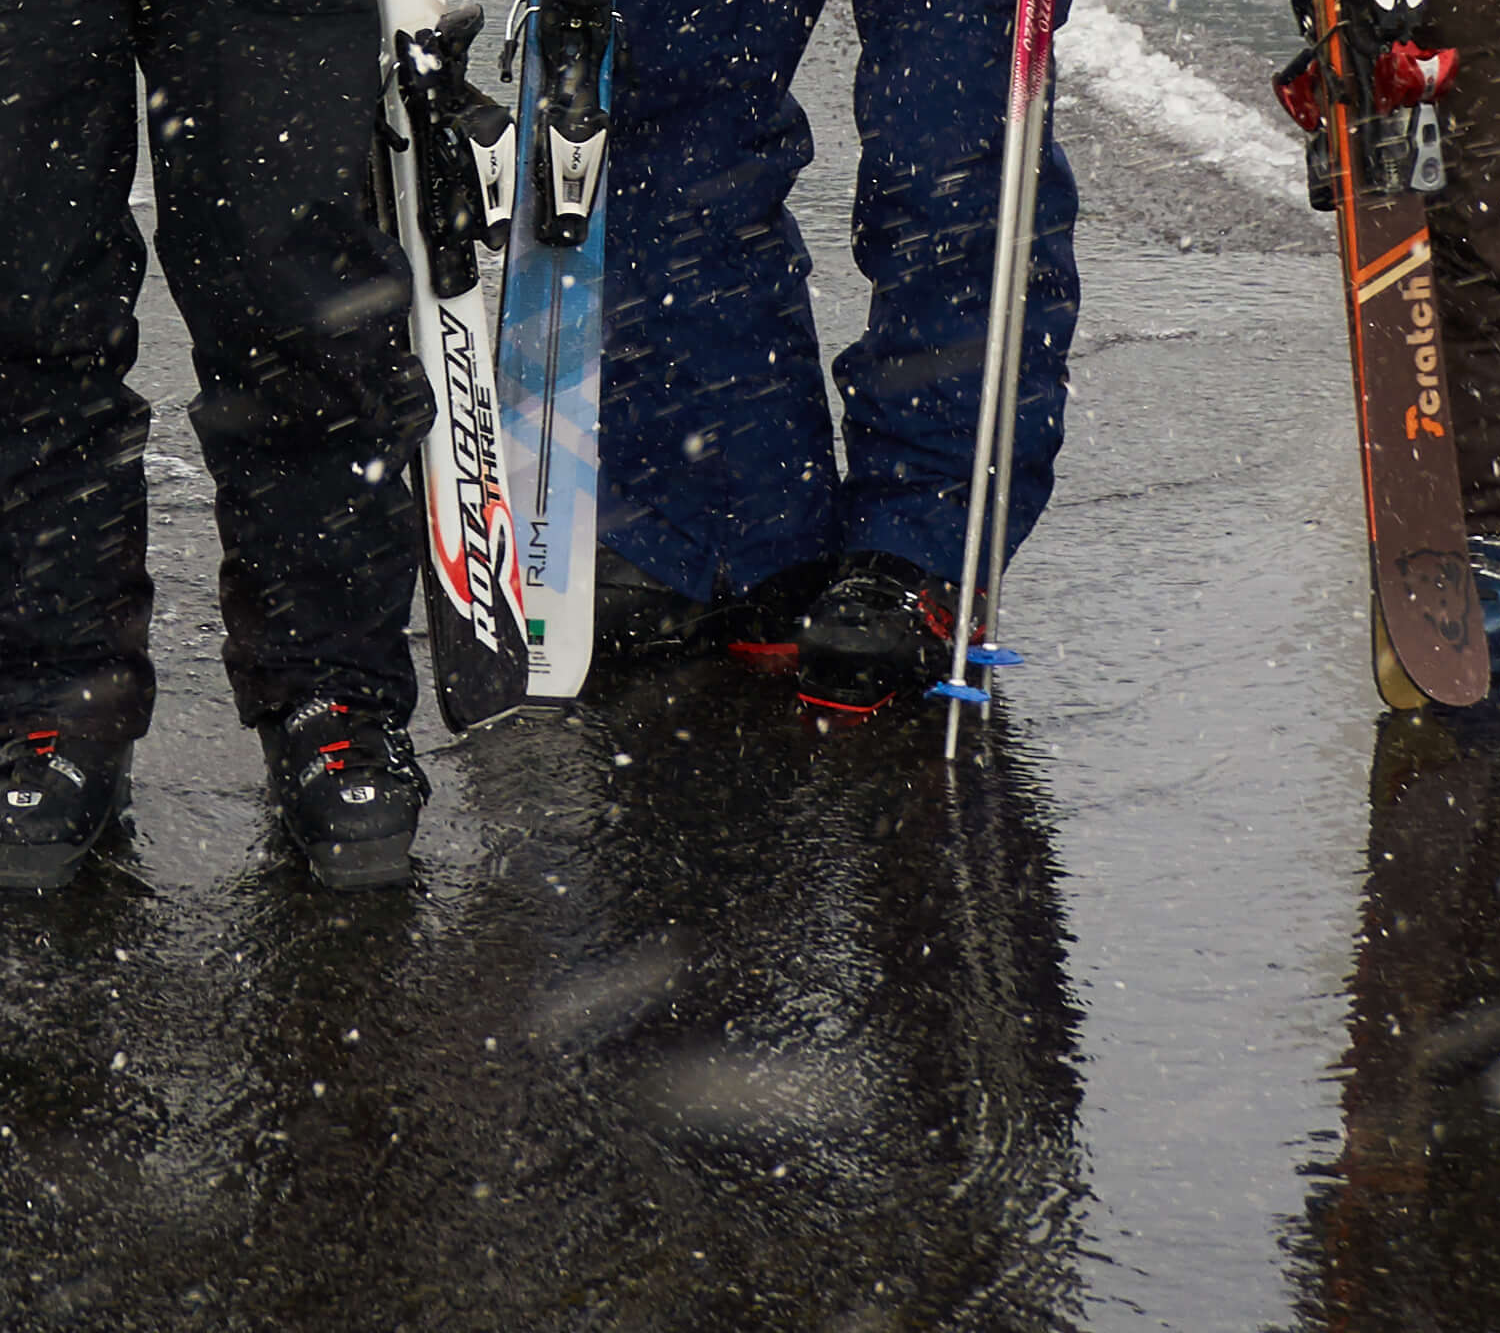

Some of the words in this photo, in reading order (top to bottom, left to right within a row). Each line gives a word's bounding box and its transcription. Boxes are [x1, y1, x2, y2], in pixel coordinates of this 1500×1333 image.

[1402, 275, 1446, 441] Scratch
[437, 303, 499, 654] ROTACION
[477, 385, 501, 505] THREE
